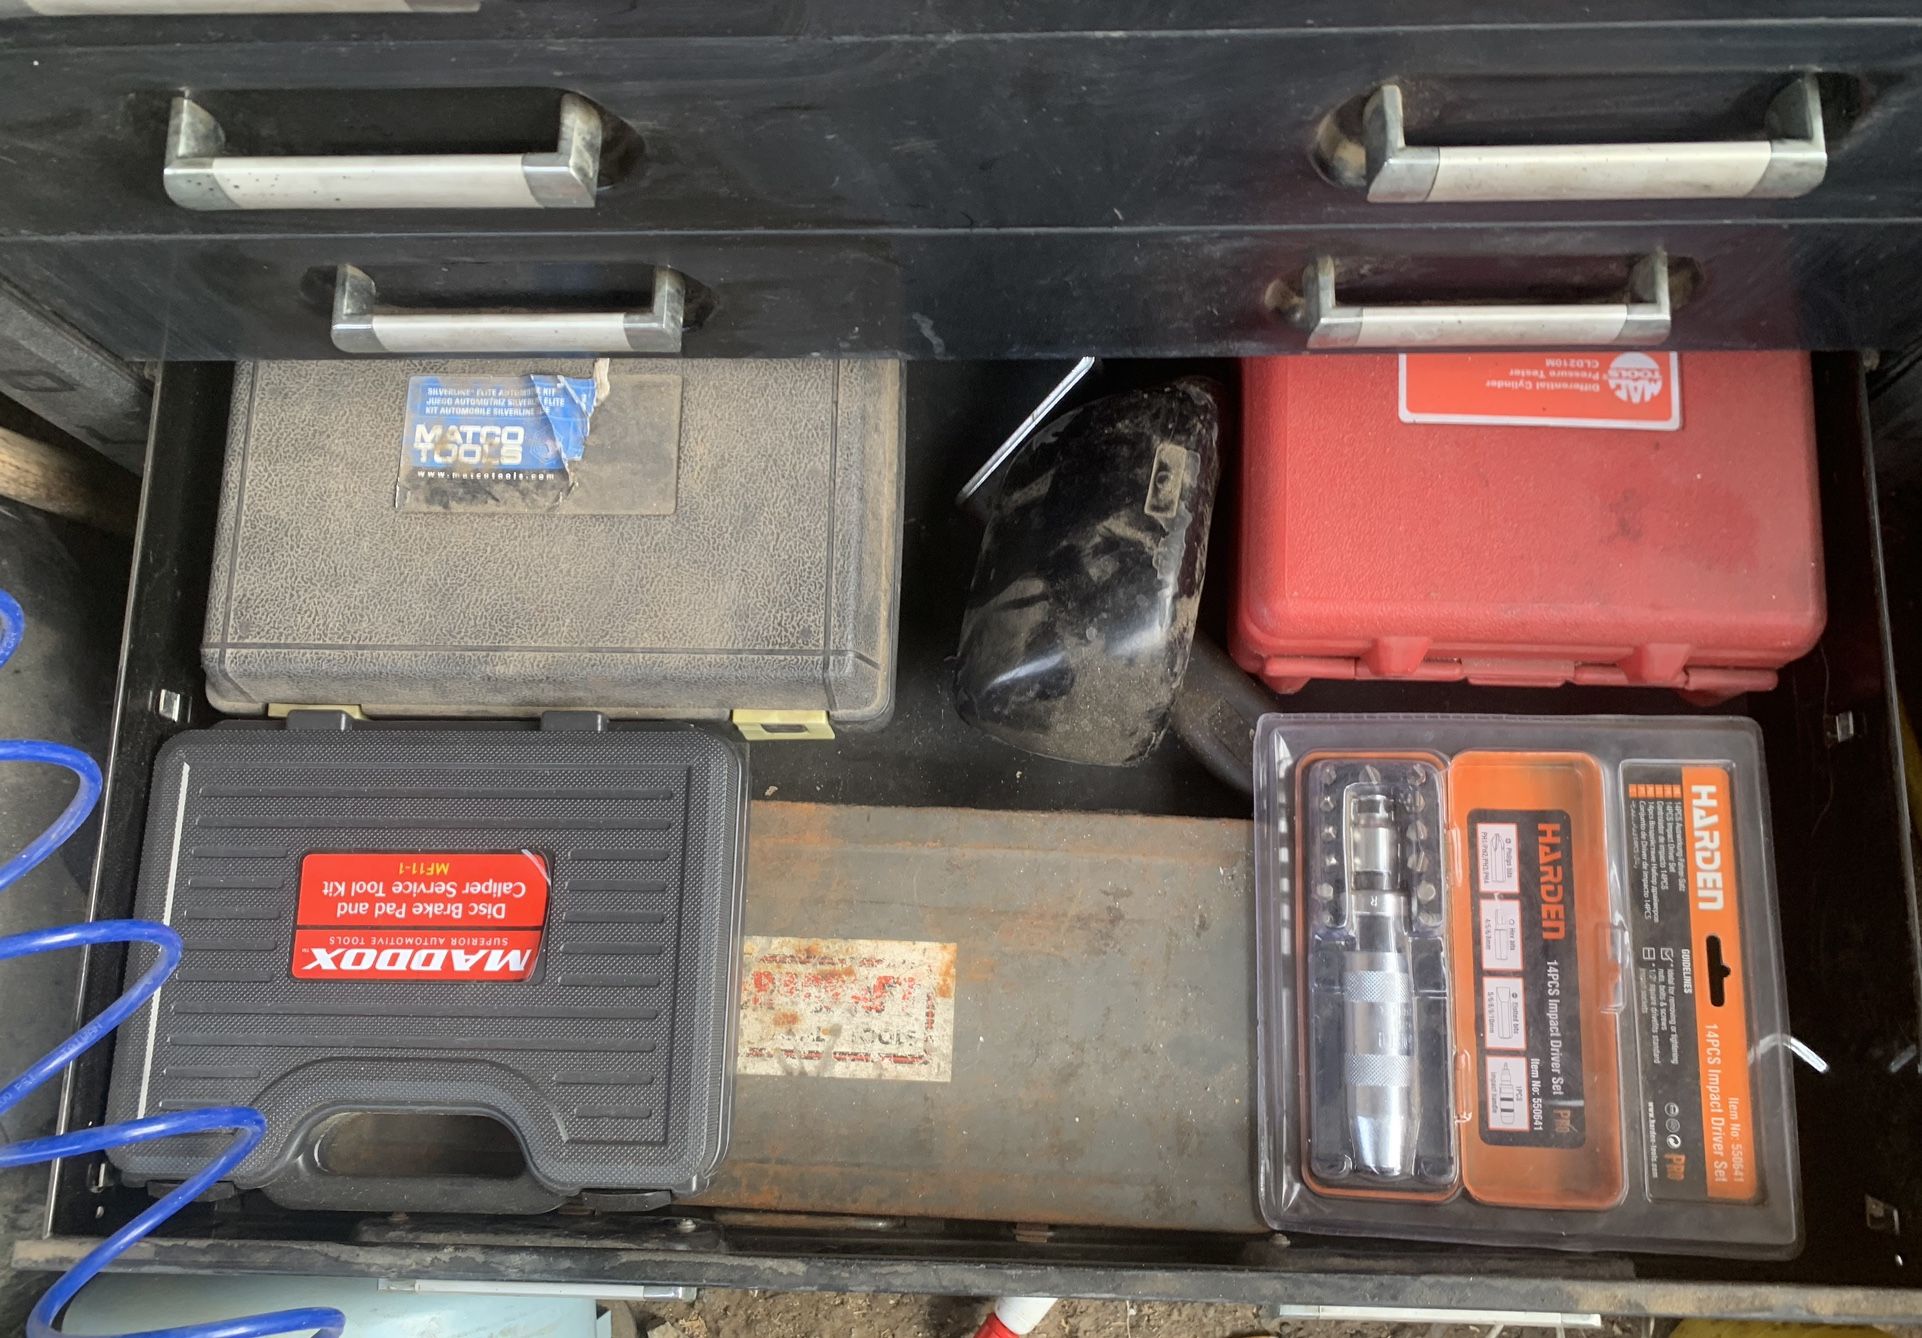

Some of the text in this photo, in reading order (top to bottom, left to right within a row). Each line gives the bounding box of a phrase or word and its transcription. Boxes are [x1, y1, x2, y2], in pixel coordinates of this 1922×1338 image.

[1545, 358, 1599, 367] CLD210M
[1509, 368, 1599, 379] Pressure Tester
[543, 387, 555, 396] KIT
[1485, 379, 1599, 391] Differential Cylinder
[1606, 378, 1662, 405] MAC
[425, 406, 438, 414] KIT
[439, 406, 491, 415] AUTOMOBILE
[543, 397, 564, 406] ELITE
[414, 423, 524, 444] MATCO
[413, 442, 522, 465] TOOLS
[1691, 783, 1723, 910] HARDEN
[398, 861, 449, 875] MF11-1
[322, 878, 526, 897] Caliper Service Tool Kit
[1537, 822, 1565, 940] HARDEN
[336, 901, 505, 918] Disc Brake Pad and
[329, 936, 508, 945] SUPERIOR AUTOMOTIVE TOOLS
[1681, 948, 1692, 993] GUIDELINES
[1546, 959, 1563, 1095] 14PCS Impact Driver Set
[1530, 1058, 1542, 1130] Item No: 550641
[1705, 1023, 1727, 1182] 14PCS Impact Driver Set
[1728, 1097, 1740, 1119] Item
[1663, 1153, 1686, 1181] PRO
[1730, 1143, 1743, 1182] 550641
